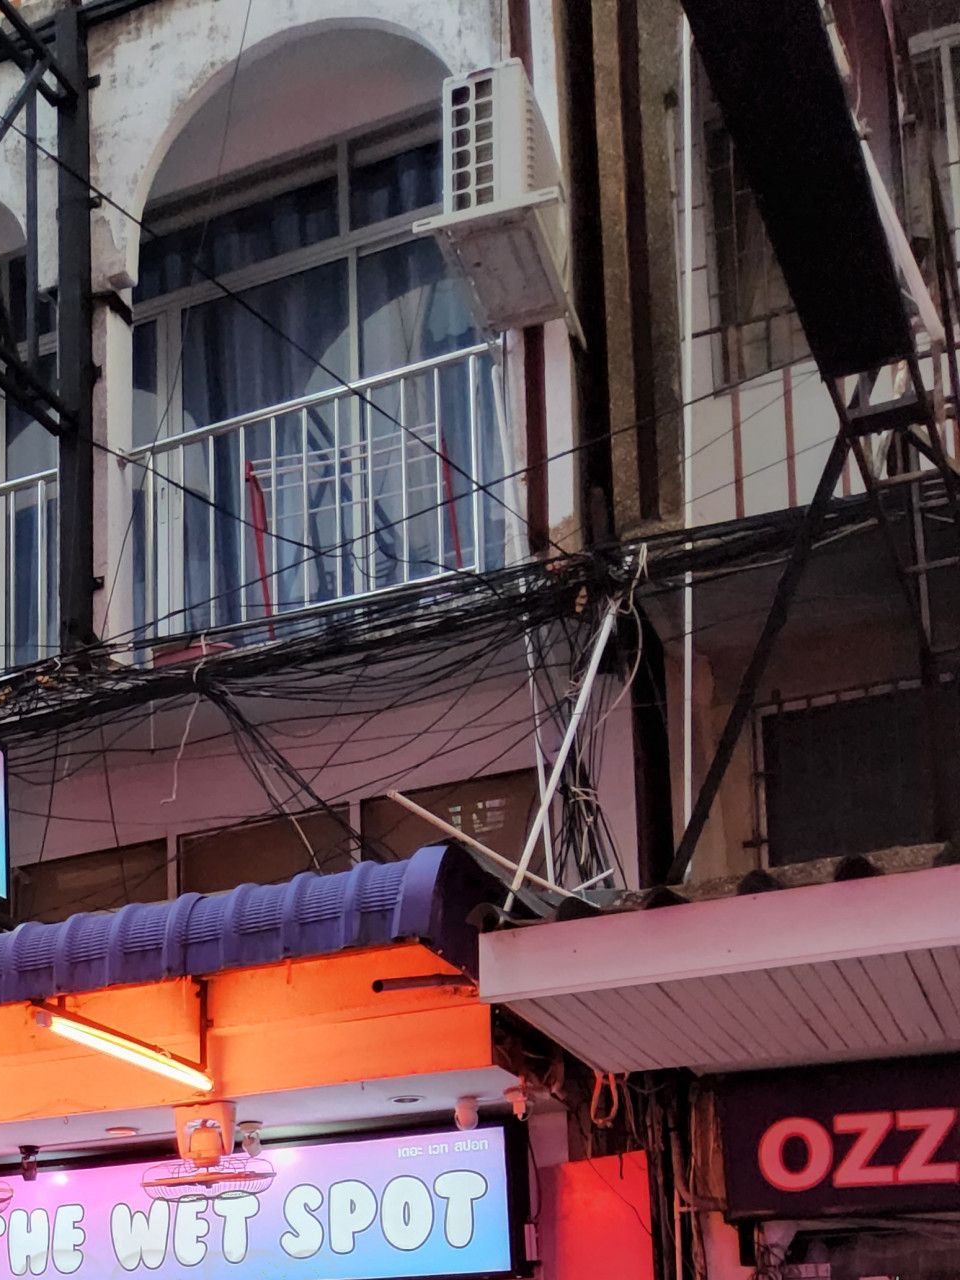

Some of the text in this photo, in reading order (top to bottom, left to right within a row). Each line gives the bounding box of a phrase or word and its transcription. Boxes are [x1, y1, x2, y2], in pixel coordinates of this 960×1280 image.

[758, 1108, 959, 1192] OZZ
[110, 1191, 260, 1271] WET
[278, 1169, 488, 1259] SPOT
